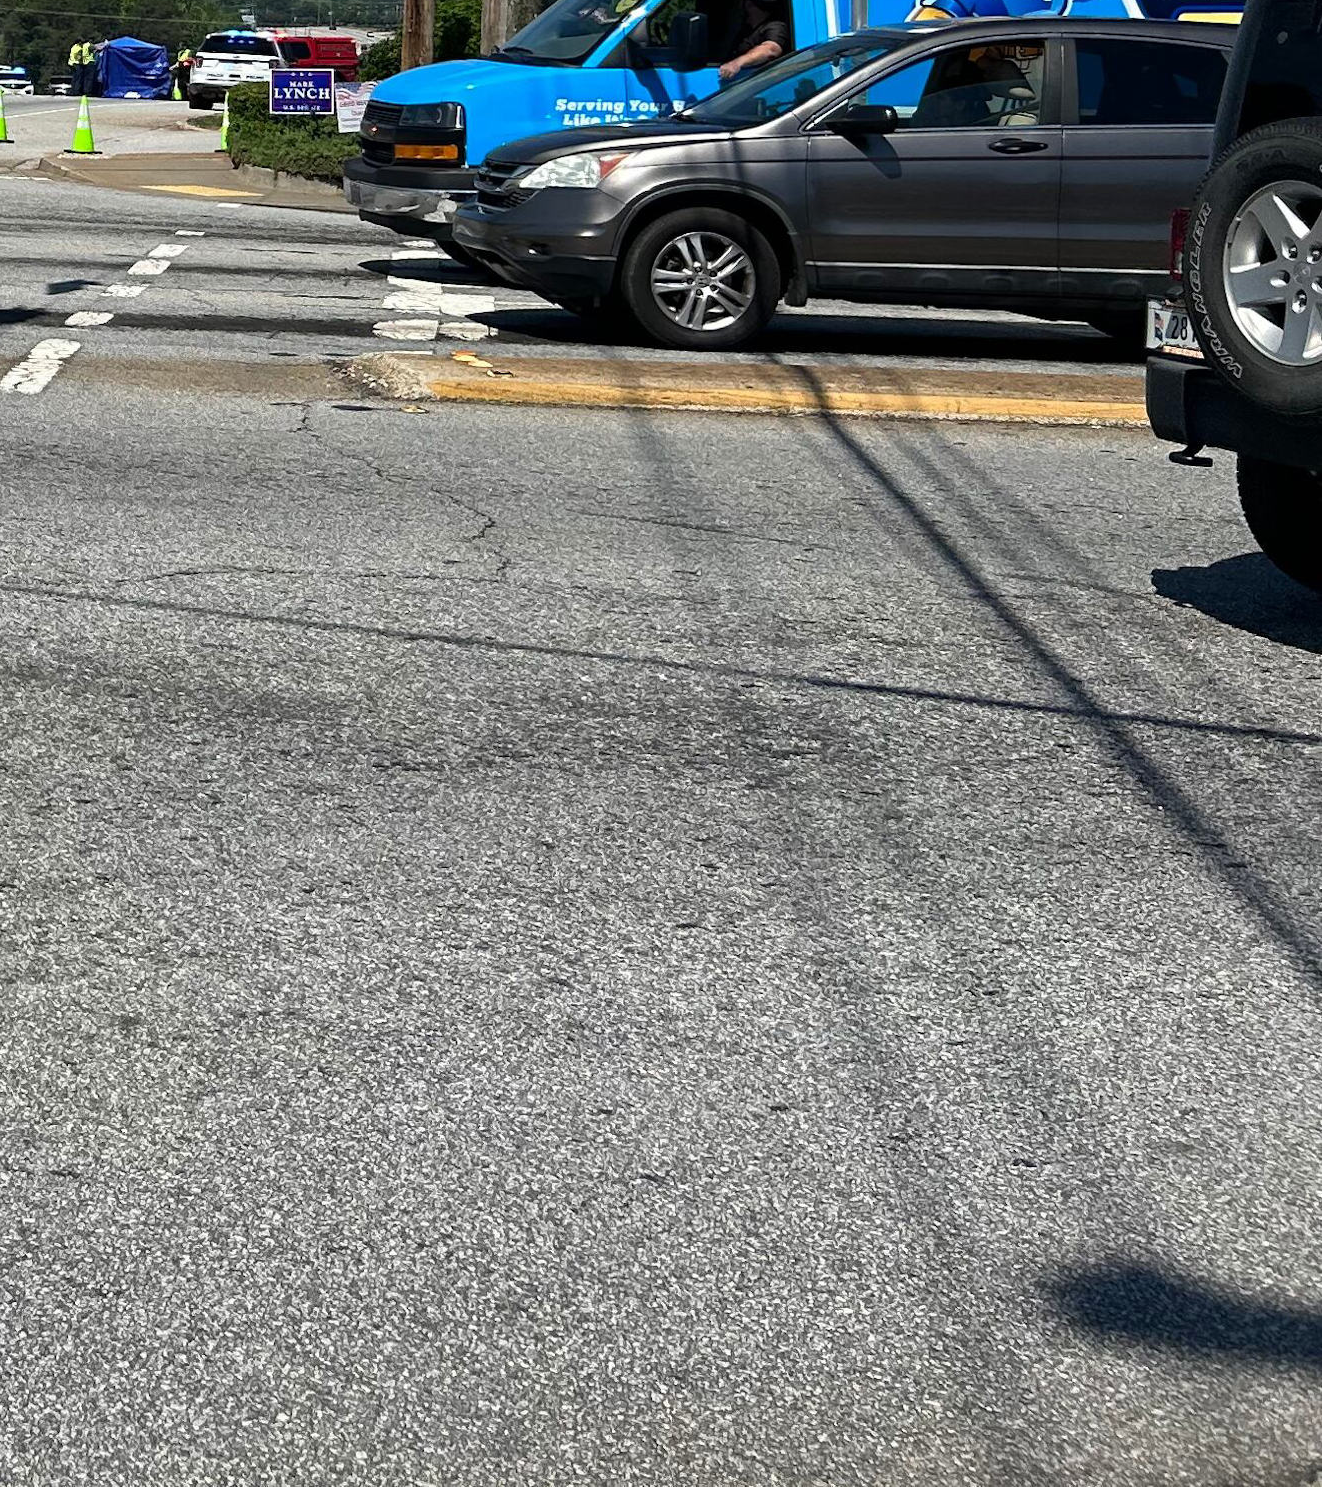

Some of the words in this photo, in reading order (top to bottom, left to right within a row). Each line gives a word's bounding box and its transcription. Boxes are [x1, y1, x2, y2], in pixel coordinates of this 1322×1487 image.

[274, 88, 330, 99] LYNCH
[555, 99, 625, 113] Serving
[629, 99, 668, 113] Your
[1188, 202, 1243, 379] WRANGLER
